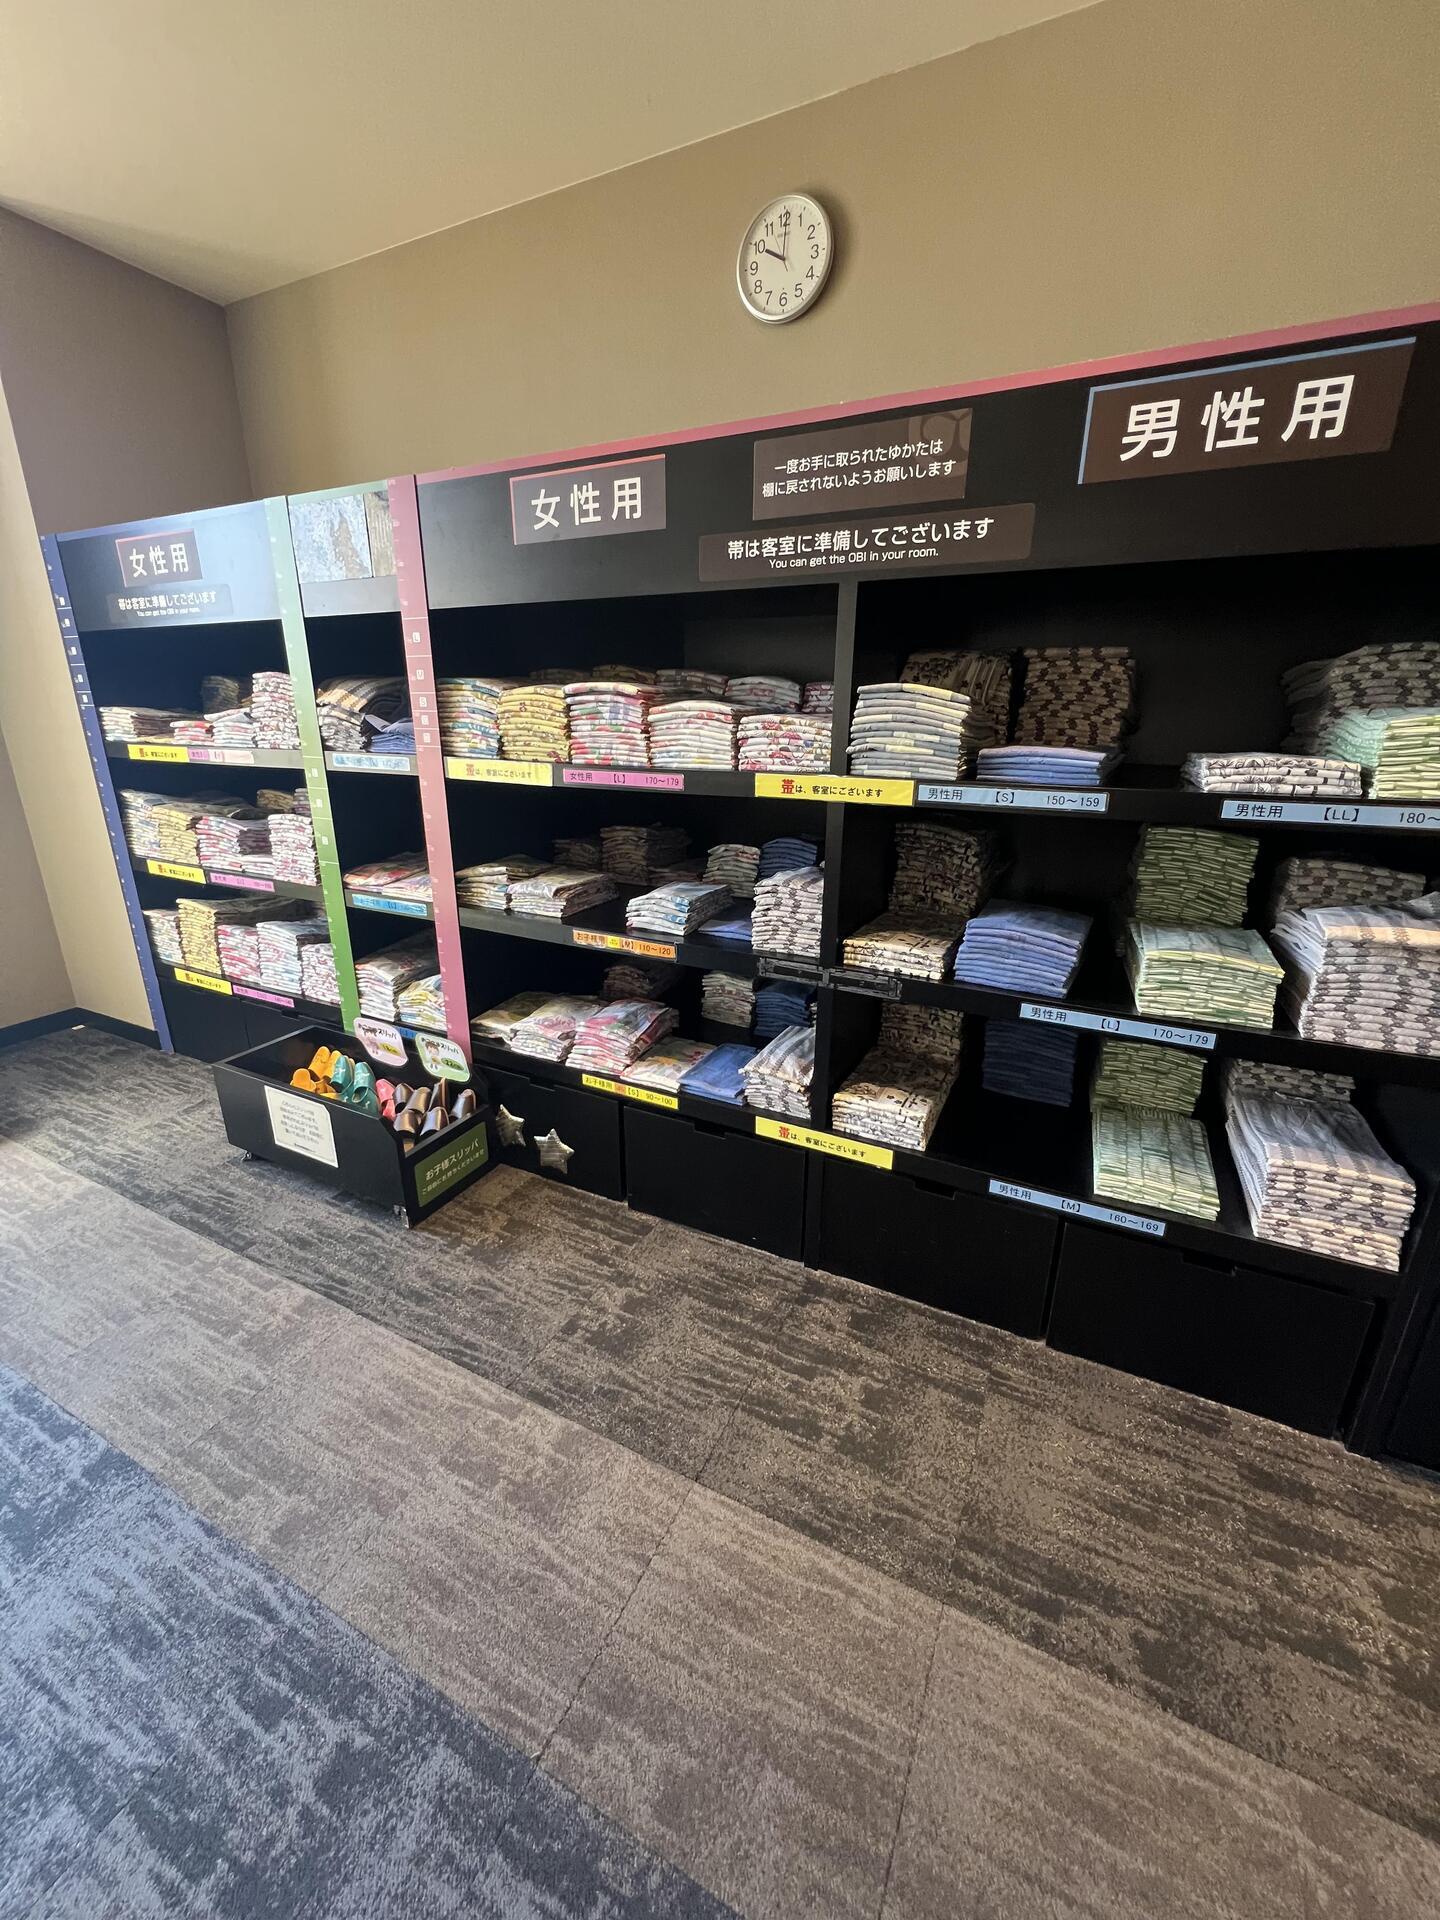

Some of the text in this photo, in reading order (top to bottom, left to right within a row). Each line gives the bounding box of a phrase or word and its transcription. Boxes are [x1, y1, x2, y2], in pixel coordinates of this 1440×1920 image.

[778, 211, 790, 227] 12
[797, 212, 802, 227] 1
[765, 221, 774, 236] 11
[807, 224, 816, 240] 2
[754, 239, 765, 255] 10
[810, 244, 819, 259] 3
[750, 261, 758, 275] 9
[806, 266, 814, 280] 4
[754, 280, 762, 294] 8
[794, 283, 803, 298] 5
[765, 291, 773, 305] 7
[779, 292, 788, 306] 6
[1119, 374, 1355, 462] 男性用
[774, 438, 943, 475] 一度お手に取られたゆかたは
[762, 459, 956, 498] 棚に戻されないようお願いします
[530, 476, 643, 531] 女性用
[727, 517, 995, 560] 帯は客室に準備してございます
[129, 543, 189, 577] 女性用
[769, 547, 939, 569] You can get the OBI in your room.
[570, 771, 592, 783] 女性用
[781, 778, 883, 798] 帯は、客室にございます
[928, 787, 963, 801] 男性用
[995, 791, 1016, 804] 【S】
[1234, 804, 1283, 818] 男性用
[1323, 807, 1360, 822] 【LL】
[1030, 1007, 1067, 1022] 男性用
[1101, 1018, 1120, 1031] 【L】
[999, 1185, 1032, 1200] 男性用
